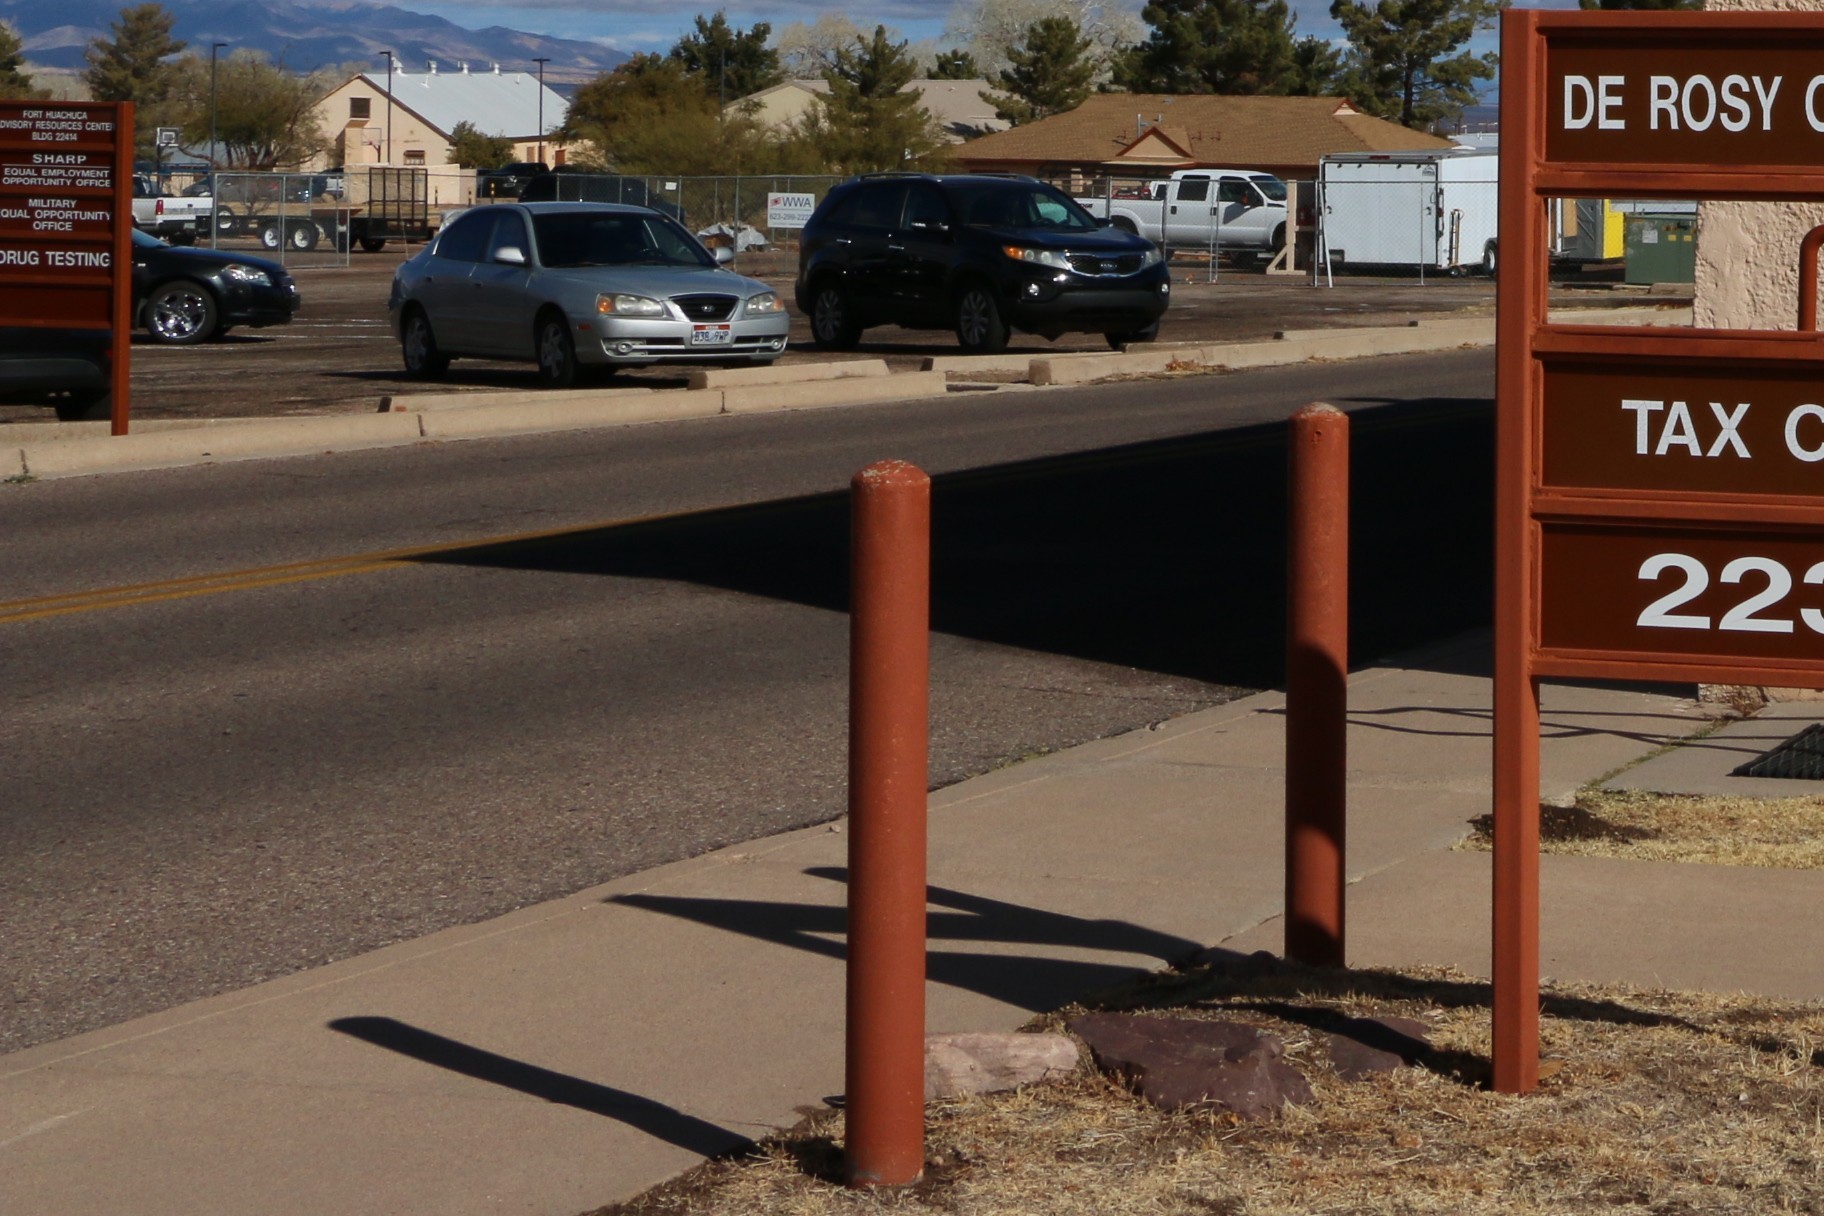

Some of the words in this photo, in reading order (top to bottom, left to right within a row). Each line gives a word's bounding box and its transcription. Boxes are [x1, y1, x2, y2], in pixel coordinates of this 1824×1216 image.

[1563, 74, 1626, 131] DE
[1649, 74, 1783, 133] ROSY
[23, 109, 43, 119] FORT
[45, 110, 88, 120] HUACHUCA
[0, 120, 33, 129] DVISORY
[35, 120, 83, 131] RESOURCES
[32, 131, 53, 141] BLDG
[55, 132, 78, 142] 22414
[32, 153, 87, 164] SHARP
[4, 167, 38, 177] EQUAL
[41, 168, 110, 178] EMPLOYMENT
[2, 176, 72, 186] OPPORTUNITY
[75, 178, 112, 188] OFFICE
[28, 198, 78, 209] MILITARY
[782, 196, 812, 208] WWA
[0, 209, 31, 219] QUAL
[34, 209, 112, 221] OPPORTUNITY
[32, 221, 73, 231] OFFICE
[0, 250, 40, 265] DRUG
[45, 251, 112, 267] TESTING
[1620, 399, 1752, 459] TAX
